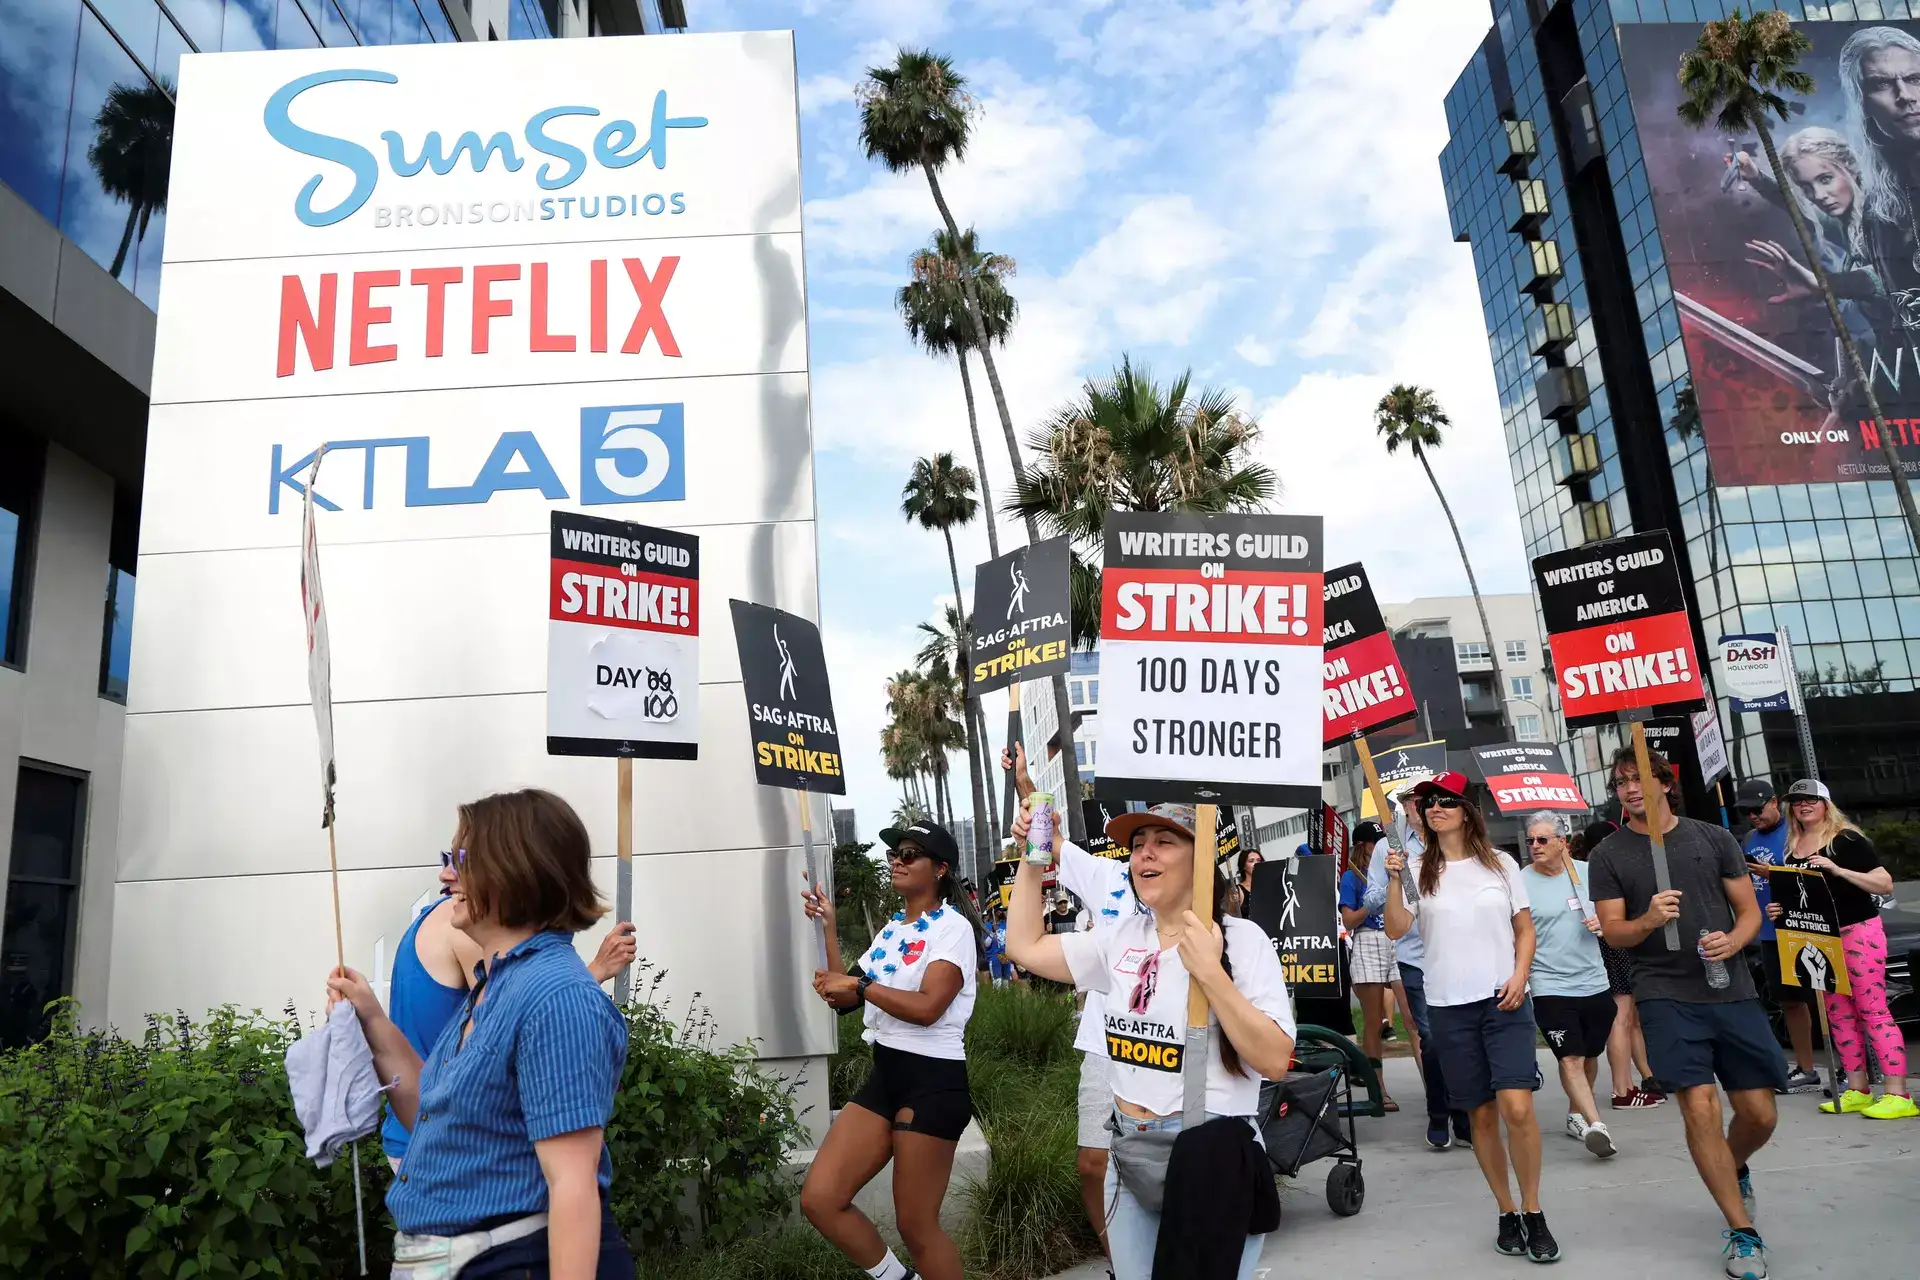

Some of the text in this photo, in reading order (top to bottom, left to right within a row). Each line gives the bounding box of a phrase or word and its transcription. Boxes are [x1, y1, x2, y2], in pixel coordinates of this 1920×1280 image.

[264, 69, 708, 227] Sunset
[276, 256, 683, 378] NETFLIX
[1780, 430, 1823, 445] ONLY
[1826, 429, 1850, 443] ON
[269, 408, 671, 515] KTLA 5
[1837, 463, 1868, 476] NETFLIX
[562, 528, 691, 568] WRITERS GUILD
[1119, 531, 1309, 560] WRITERS GUILD
[620, 562, 638, 577] ON
[1200, 562, 1225, 579] ON
[1543, 548, 1664, 587] WRITERS GUILD
[1597, 578, 1616, 595] OF
[560, 571, 690, 628] STRIKE!
[1116, 581, 1309, 637] STRIKE!
[1576, 593, 1649, 622] AMERICA
[1323, 619, 1356, 644] RICA
[1007, 637, 1026, 652] ON
[1605, 631, 1636, 654] ON
[973, 639, 1066, 683] STRIKE!
[1727, 646, 1776, 663] DASH
[596, 664, 642, 688] DAY
[1137, 656, 1281, 696] 100 DAYS
[1323, 657, 1350, 681] ON
[1562, 646, 1692, 699] STRIKE!
[1727, 663, 1769, 672] HOLLYWOOD
[1323, 664, 1405, 722] RIKE!
[643, 695, 679, 719] 100
[787, 732, 804, 747] ON
[1132, 718, 1282, 759] STRONGER
[1643, 726, 1680, 738] RITERS GUILD
[1479, 747, 1553, 759] WRITERS GUILD
[1653, 740, 1661, 749] OF
[757, 743, 841, 777] STRIKE!
[1502, 763, 1548, 773] AMERICA
[1522, 776, 1542, 785] ON
[1496, 786, 1579, 804] STRIKE!
[1106, 842, 1116, 850] ON
[1220, 837, 1228, 845] ON
[1326, 831, 1333, 848] ON
[1785, 918, 1830, 933] ON STRIKE!
[1281, 953, 1298, 963] ON
[1281, 964, 1335, 983] RIKE!
[1108, 1036, 1179, 1068] TRONG
